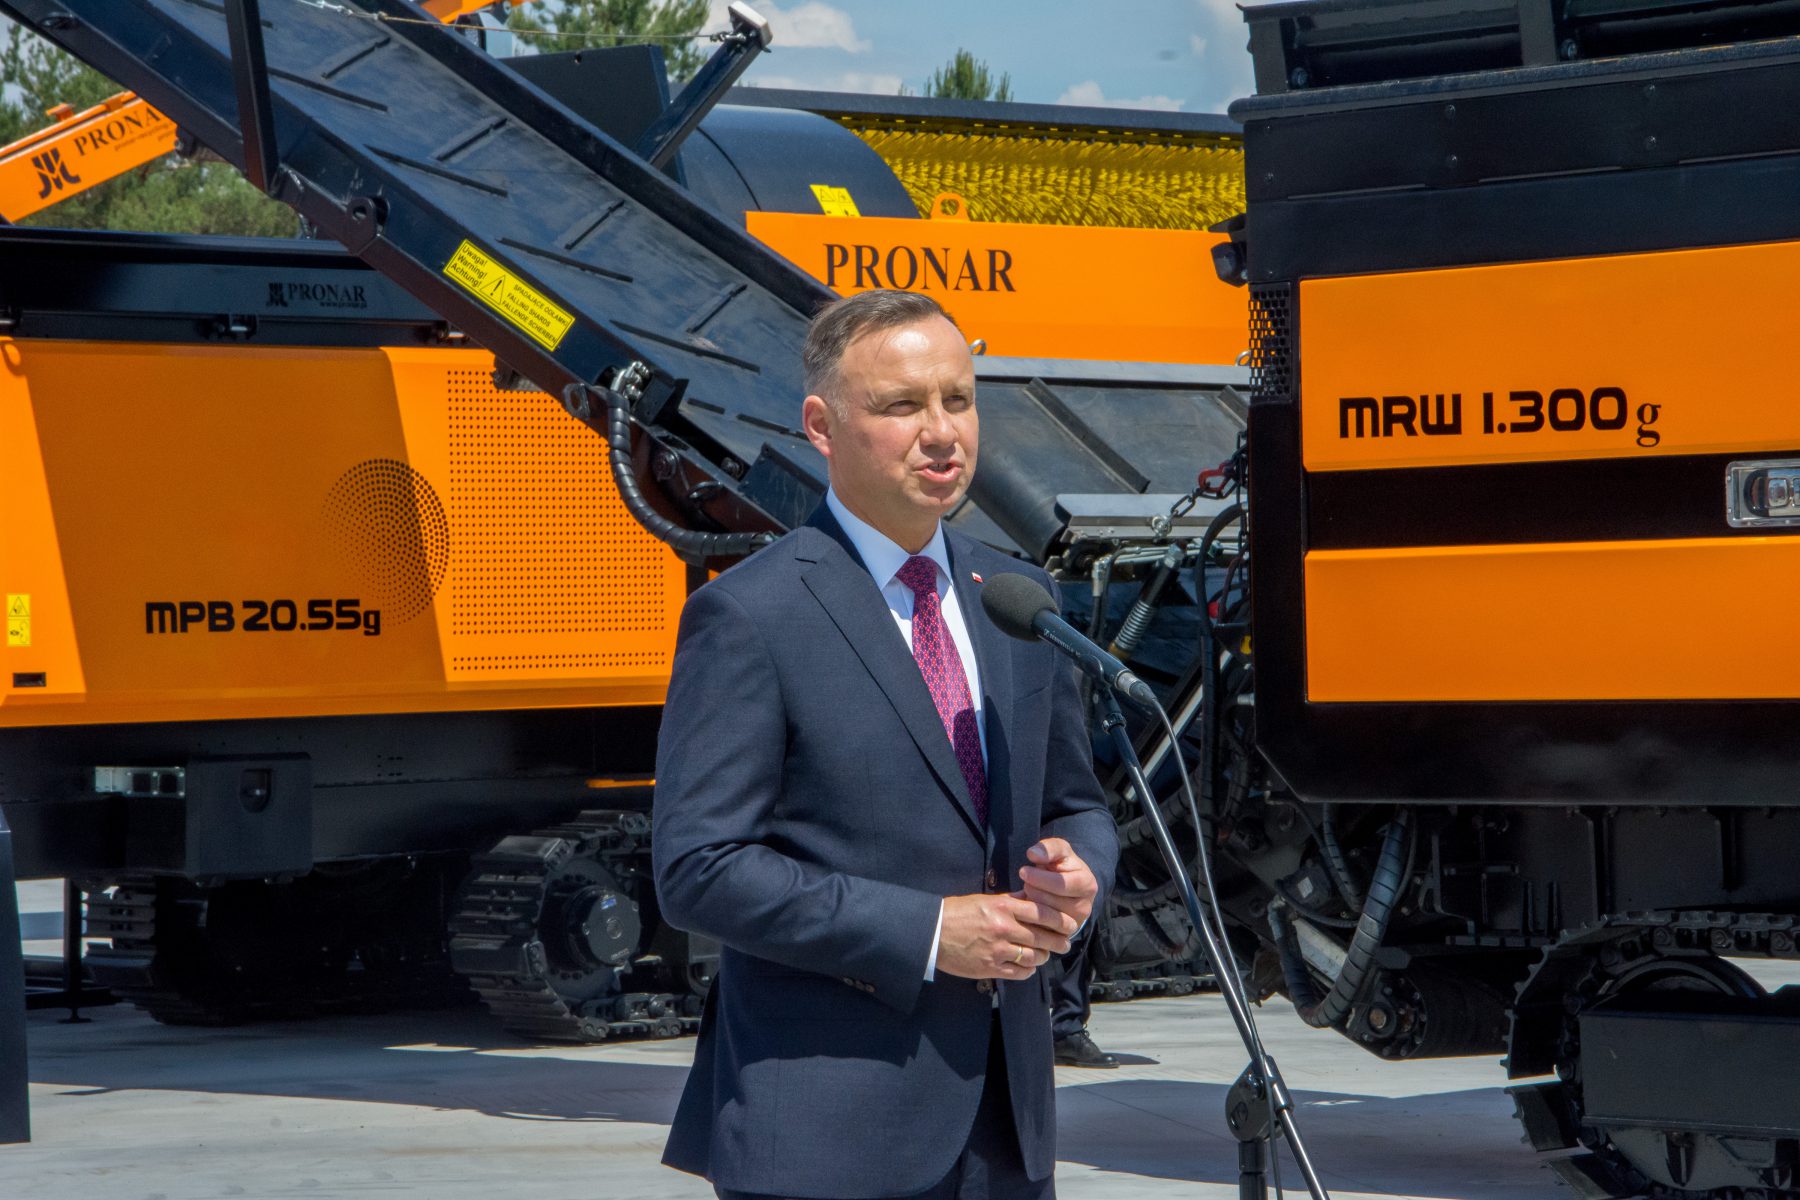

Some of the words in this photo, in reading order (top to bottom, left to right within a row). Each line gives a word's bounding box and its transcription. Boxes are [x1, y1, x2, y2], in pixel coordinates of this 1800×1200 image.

[73, 106, 161, 156] PRONA
[457, 254, 488, 279] Warning!
[462, 244, 488, 267] Uwaga!
[823, 243, 1017, 293] PRONAR
[450, 263, 482, 288] Achtung!
[287, 282, 366, 302] PRONAR
[1339, 393, 1462, 438] MRW
[146, 600, 235, 634] MPB
[242, 598, 381, 636] 20.55g
